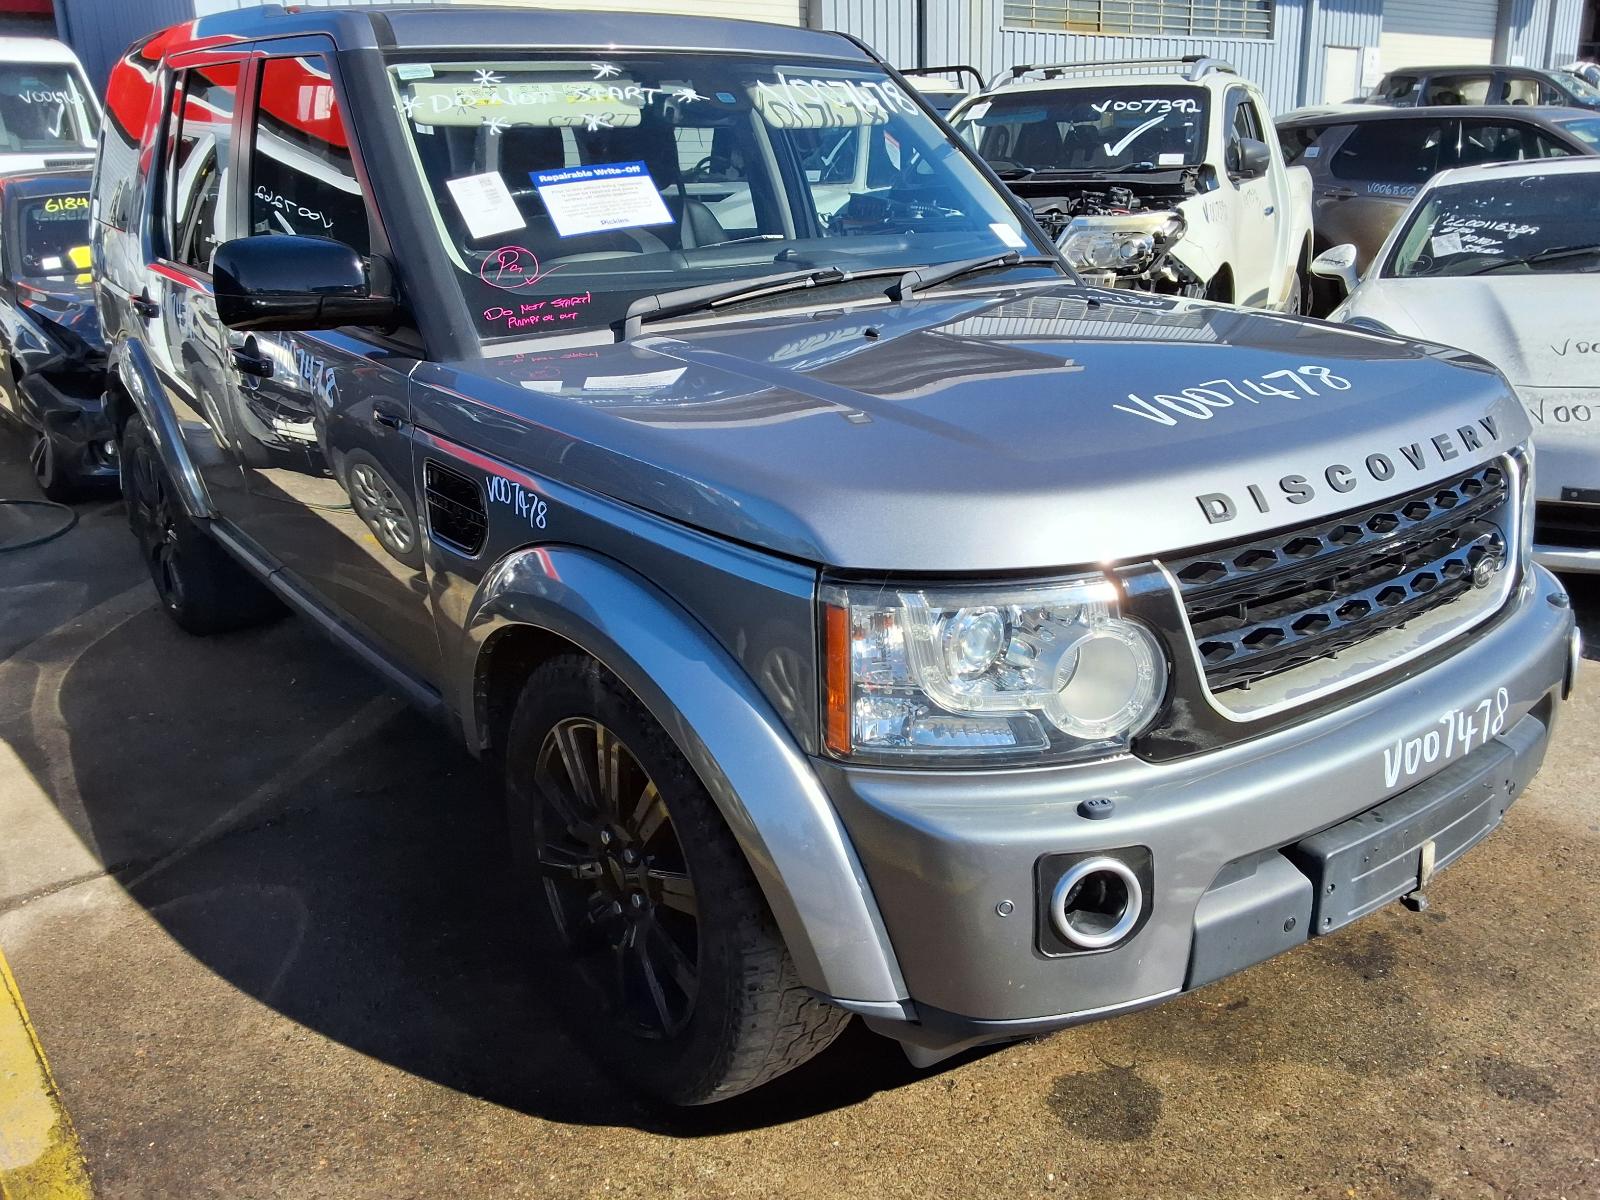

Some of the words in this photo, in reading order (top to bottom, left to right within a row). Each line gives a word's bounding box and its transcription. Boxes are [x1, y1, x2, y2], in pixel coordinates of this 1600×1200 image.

[431, 94, 477, 113] DO
[1090, 98, 1202, 113] V007392
[538, 169, 593, 183] Repairable
[593, 165, 641, 177] Write-Off
[1112, 364, 1352, 427] V007478
[1529, 398, 1600, 425] V00
[1194, 415, 1501, 525] DISCOVERY
[485, 476, 548, 529] V007478
[1383, 686, 1509, 789] V007478
